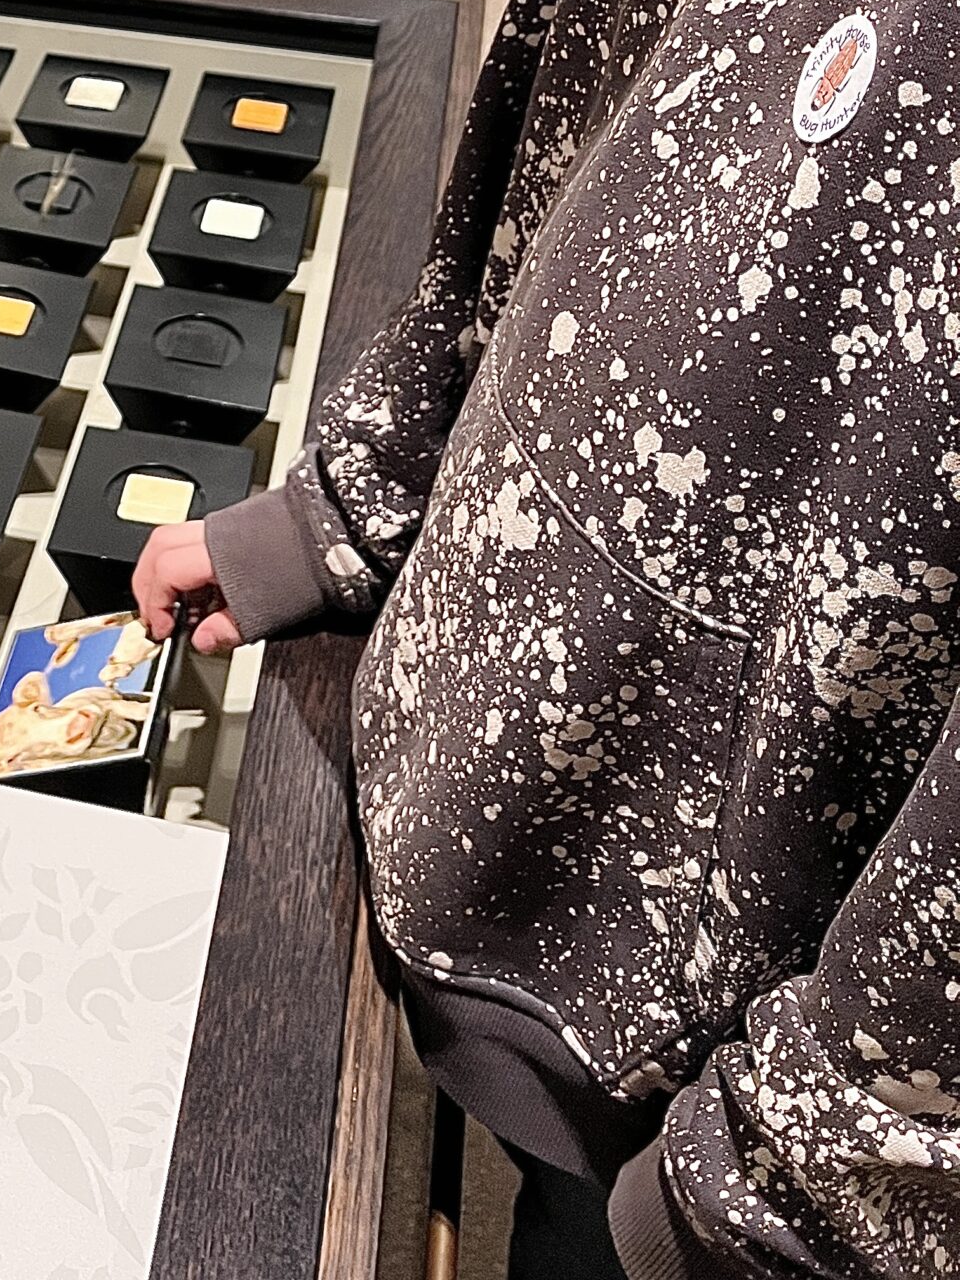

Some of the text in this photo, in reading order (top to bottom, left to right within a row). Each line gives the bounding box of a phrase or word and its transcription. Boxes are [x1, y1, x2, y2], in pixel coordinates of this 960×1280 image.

[804, 25, 870, 80] Trinity House
[799, 91, 862, 137] Bug Hunter
